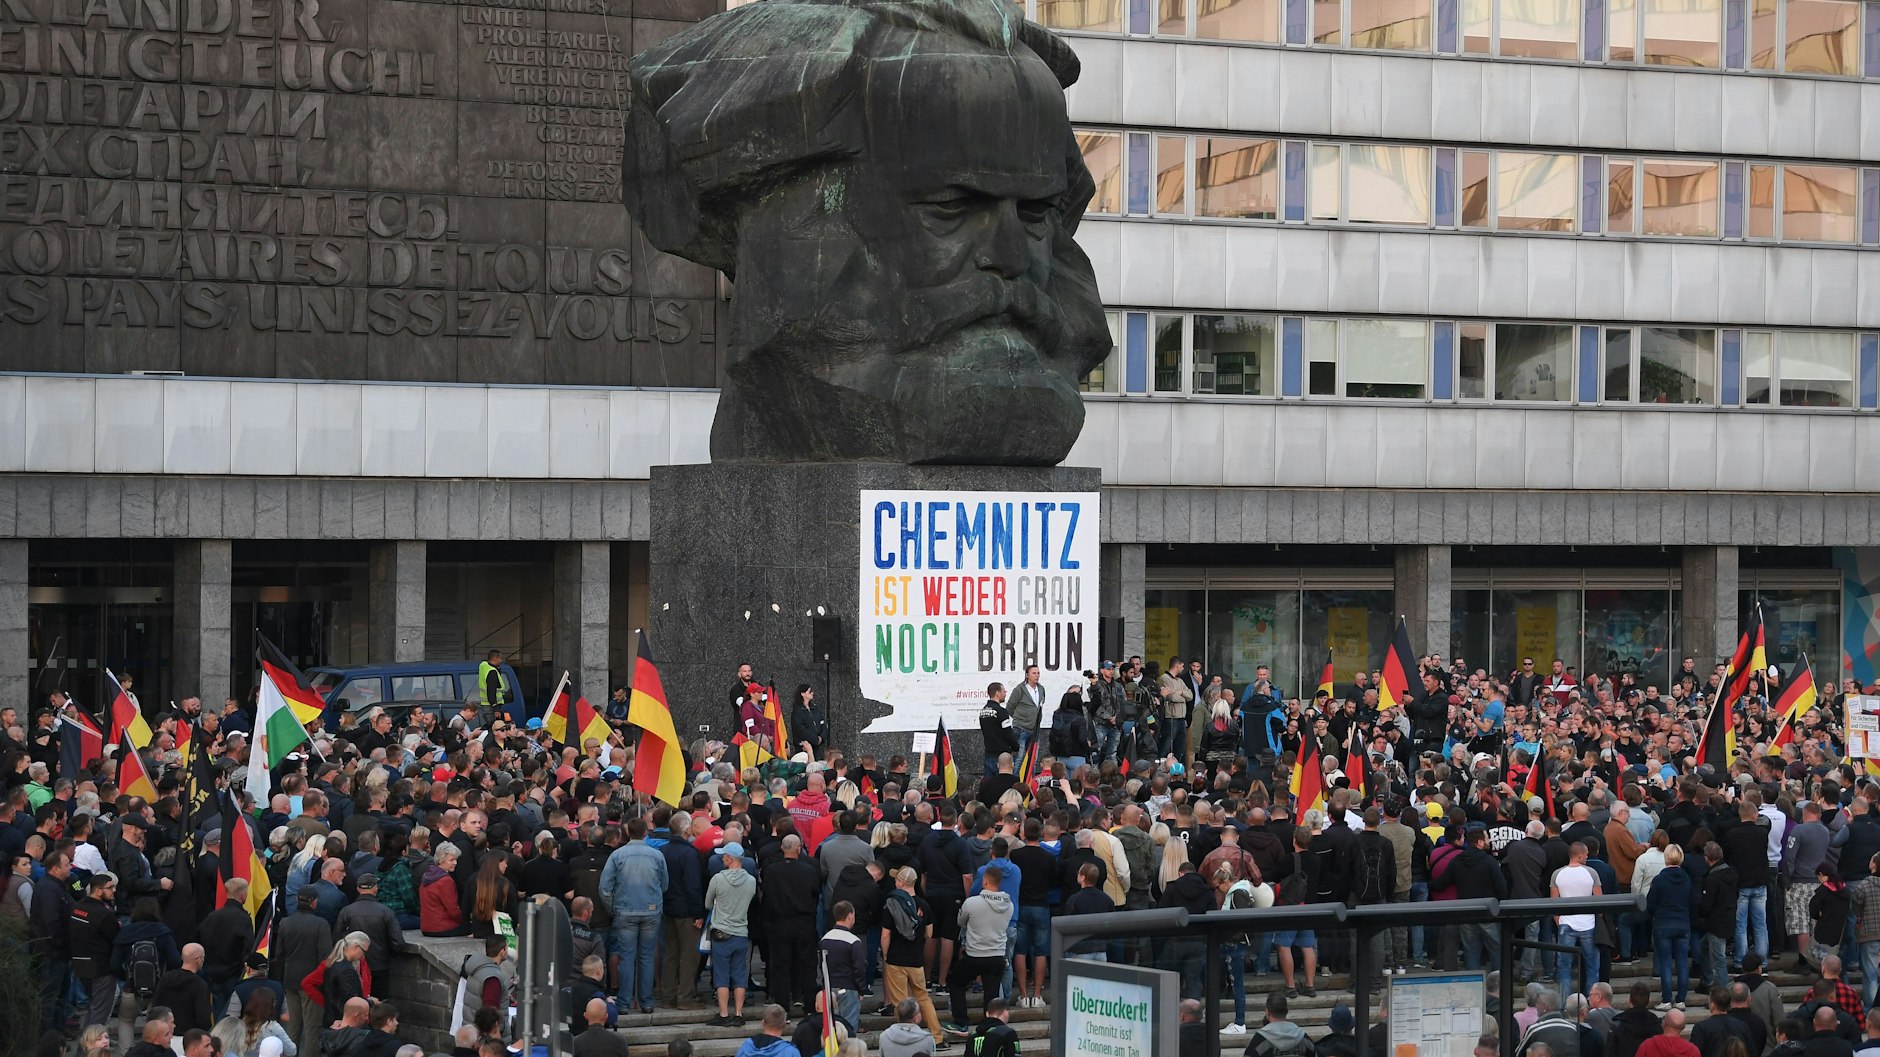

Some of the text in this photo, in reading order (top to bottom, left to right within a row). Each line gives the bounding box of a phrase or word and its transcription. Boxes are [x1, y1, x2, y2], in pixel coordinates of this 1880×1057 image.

[463, 6, 532, 28] UNITE!
[477, 27, 622, 53] PROLETARIER
[485, 46, 546, 67] ALLER
[239, 40, 436, 96] EUCH!
[495, 65, 609, 90] VEREINIGT
[87, 130, 314, 187] СТРАН,
[368, 241, 454, 289] DE
[458, 243, 633, 296] TOUS
[63, 278, 239, 330] PAYS,
[874, 501, 1081, 570] CHEMNITZ
[874, 575, 1081, 616] IST WEDER GRAU
[875, 621, 1083, 675] NOCH BRAUN
[1072, 986, 1147, 1023] Überzuckert!
[1086, 1020, 1132, 1041] Chemnitz isst
[1087, 1039, 1112, 1055] Tonnen
[1114, 1046, 1125, 1057] am
